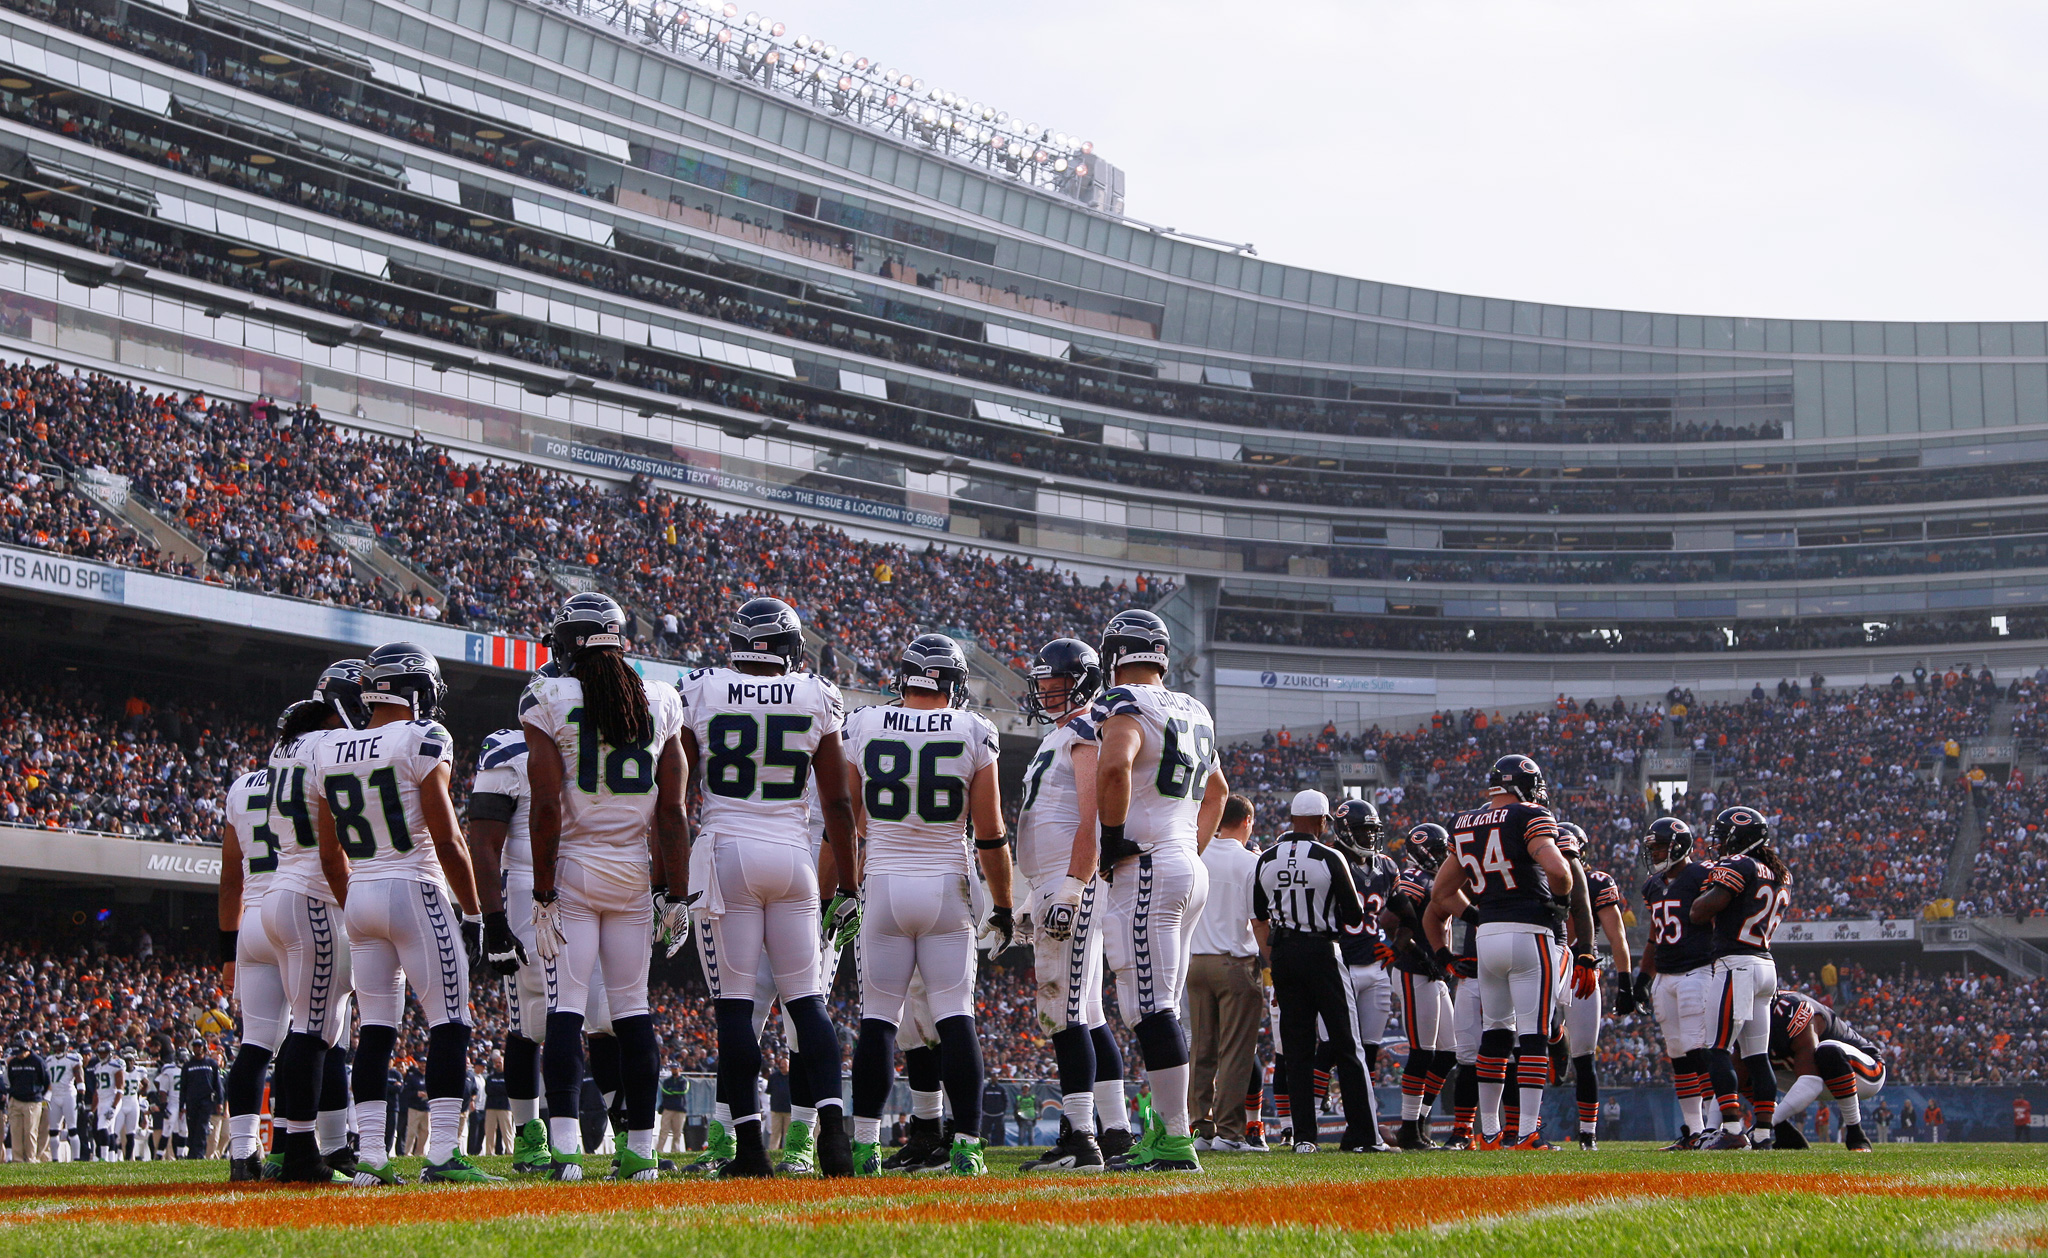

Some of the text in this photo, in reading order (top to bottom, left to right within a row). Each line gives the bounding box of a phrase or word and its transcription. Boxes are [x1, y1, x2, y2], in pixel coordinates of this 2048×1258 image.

[546, 441, 568, 457] FOR
[571, 444, 684, 480] SECURITY/ASSISTANCE
[686, 470, 710, 484] TEXT
[795, 491, 813, 504] THE
[815, 495, 842, 510] ISSUE
[844, 501, 851, 511] &
[853, 501, 900, 519] LOCATION
[902, 511, 914, 522] TO
[915, 513, 945, 527] 69050
[111, 492, 126, 506] 312
[359, 541, 371, 553] 313
[0, 555, 26, 578] TS
[31, 560, 71, 585] AND
[1132, 654, 1166, 662] SEATTLE
[1283, 675, 1329, 688] ZURICH
[1336, 678, 1370, 691] Skyline
[1371, 679, 1395, 691] Suite
[883, 711, 953, 733] MILLER
[335, 735, 383, 764] TATE
[565, 705, 656, 796] 18
[706, 713, 814, 801] 85
[1154, 716, 1215, 803] 68
[864, 738, 967, 824] 86
[323, 765, 415, 860] 81
[1454, 808, 1509, 830] URLACHER
[147, 854, 222, 876] MILLER
[1287, 858, 1297, 869] R
[1453, 827, 1519, 895] 54
[1277, 869, 1308, 888] 94
[1651, 899, 1683, 945] 55
[1737, 883, 1791, 950] 26
[1953, 928, 1968, 940] 121
[49, 1065, 66, 1084] 17
